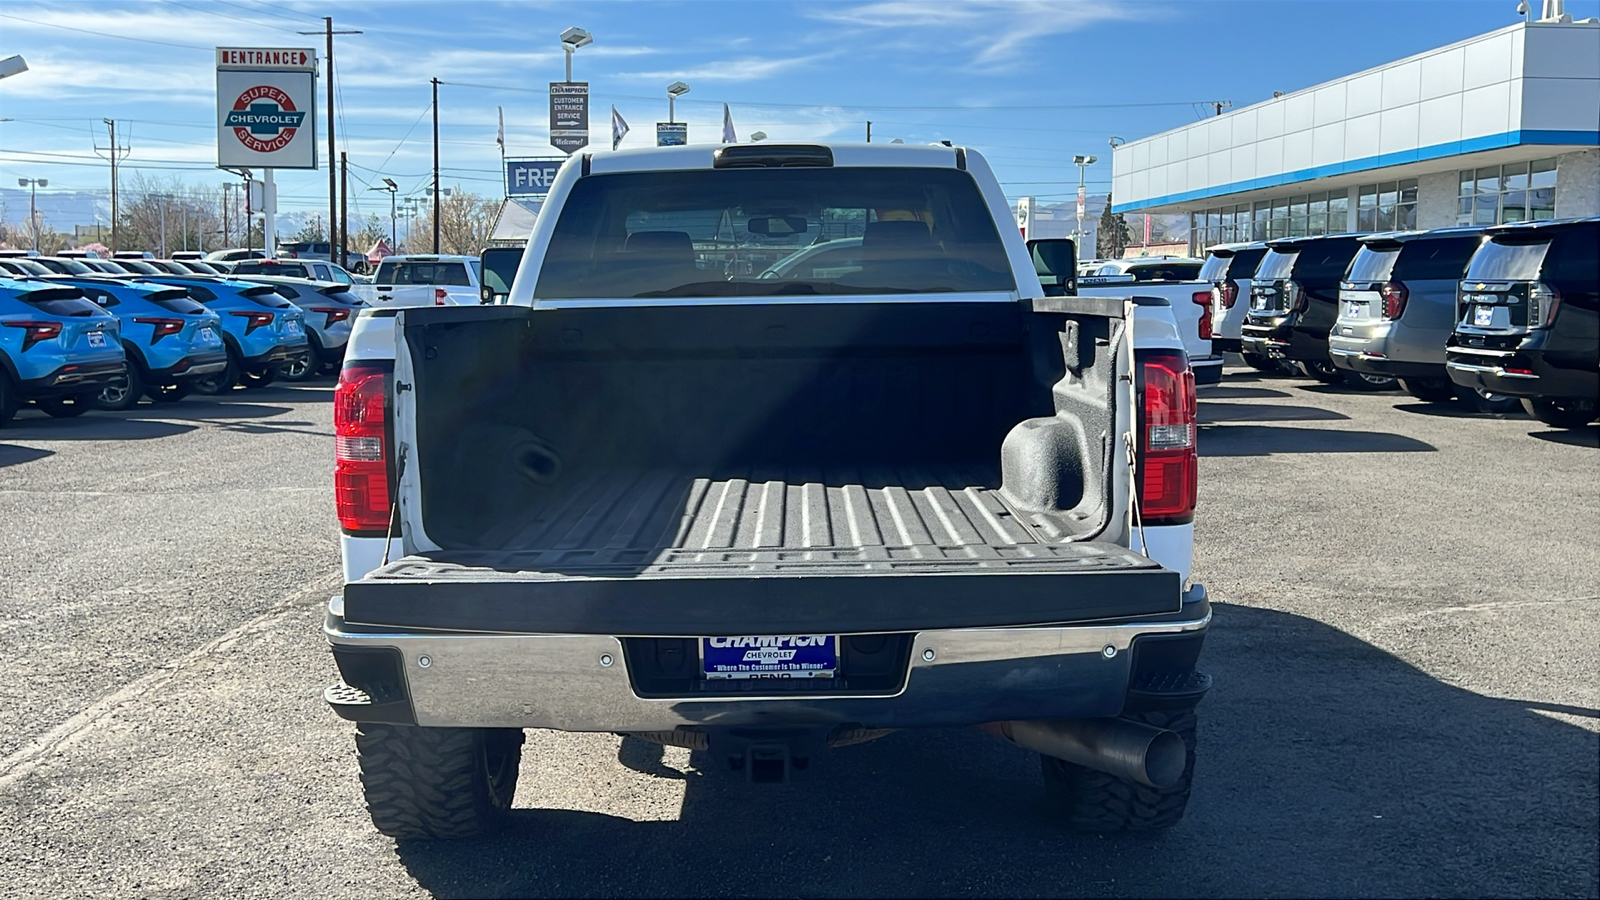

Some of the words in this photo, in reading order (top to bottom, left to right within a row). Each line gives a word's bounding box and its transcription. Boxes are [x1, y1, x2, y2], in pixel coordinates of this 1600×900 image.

[231, 50, 298, 65] ENTRANCE
[241, 87, 287, 104] SUPER
[551, 86, 588, 94] CHAMPION
[229, 115, 300, 124] CHEVROLET
[238, 129, 293, 151] SERVICE
[554, 138, 584, 146] Welcome!
[515, 166, 559, 188] FRE
[709, 635, 827, 648] CHAMPION
[746, 651, 793, 659] CHEVROLET
[751, 663, 781, 671] Customer
